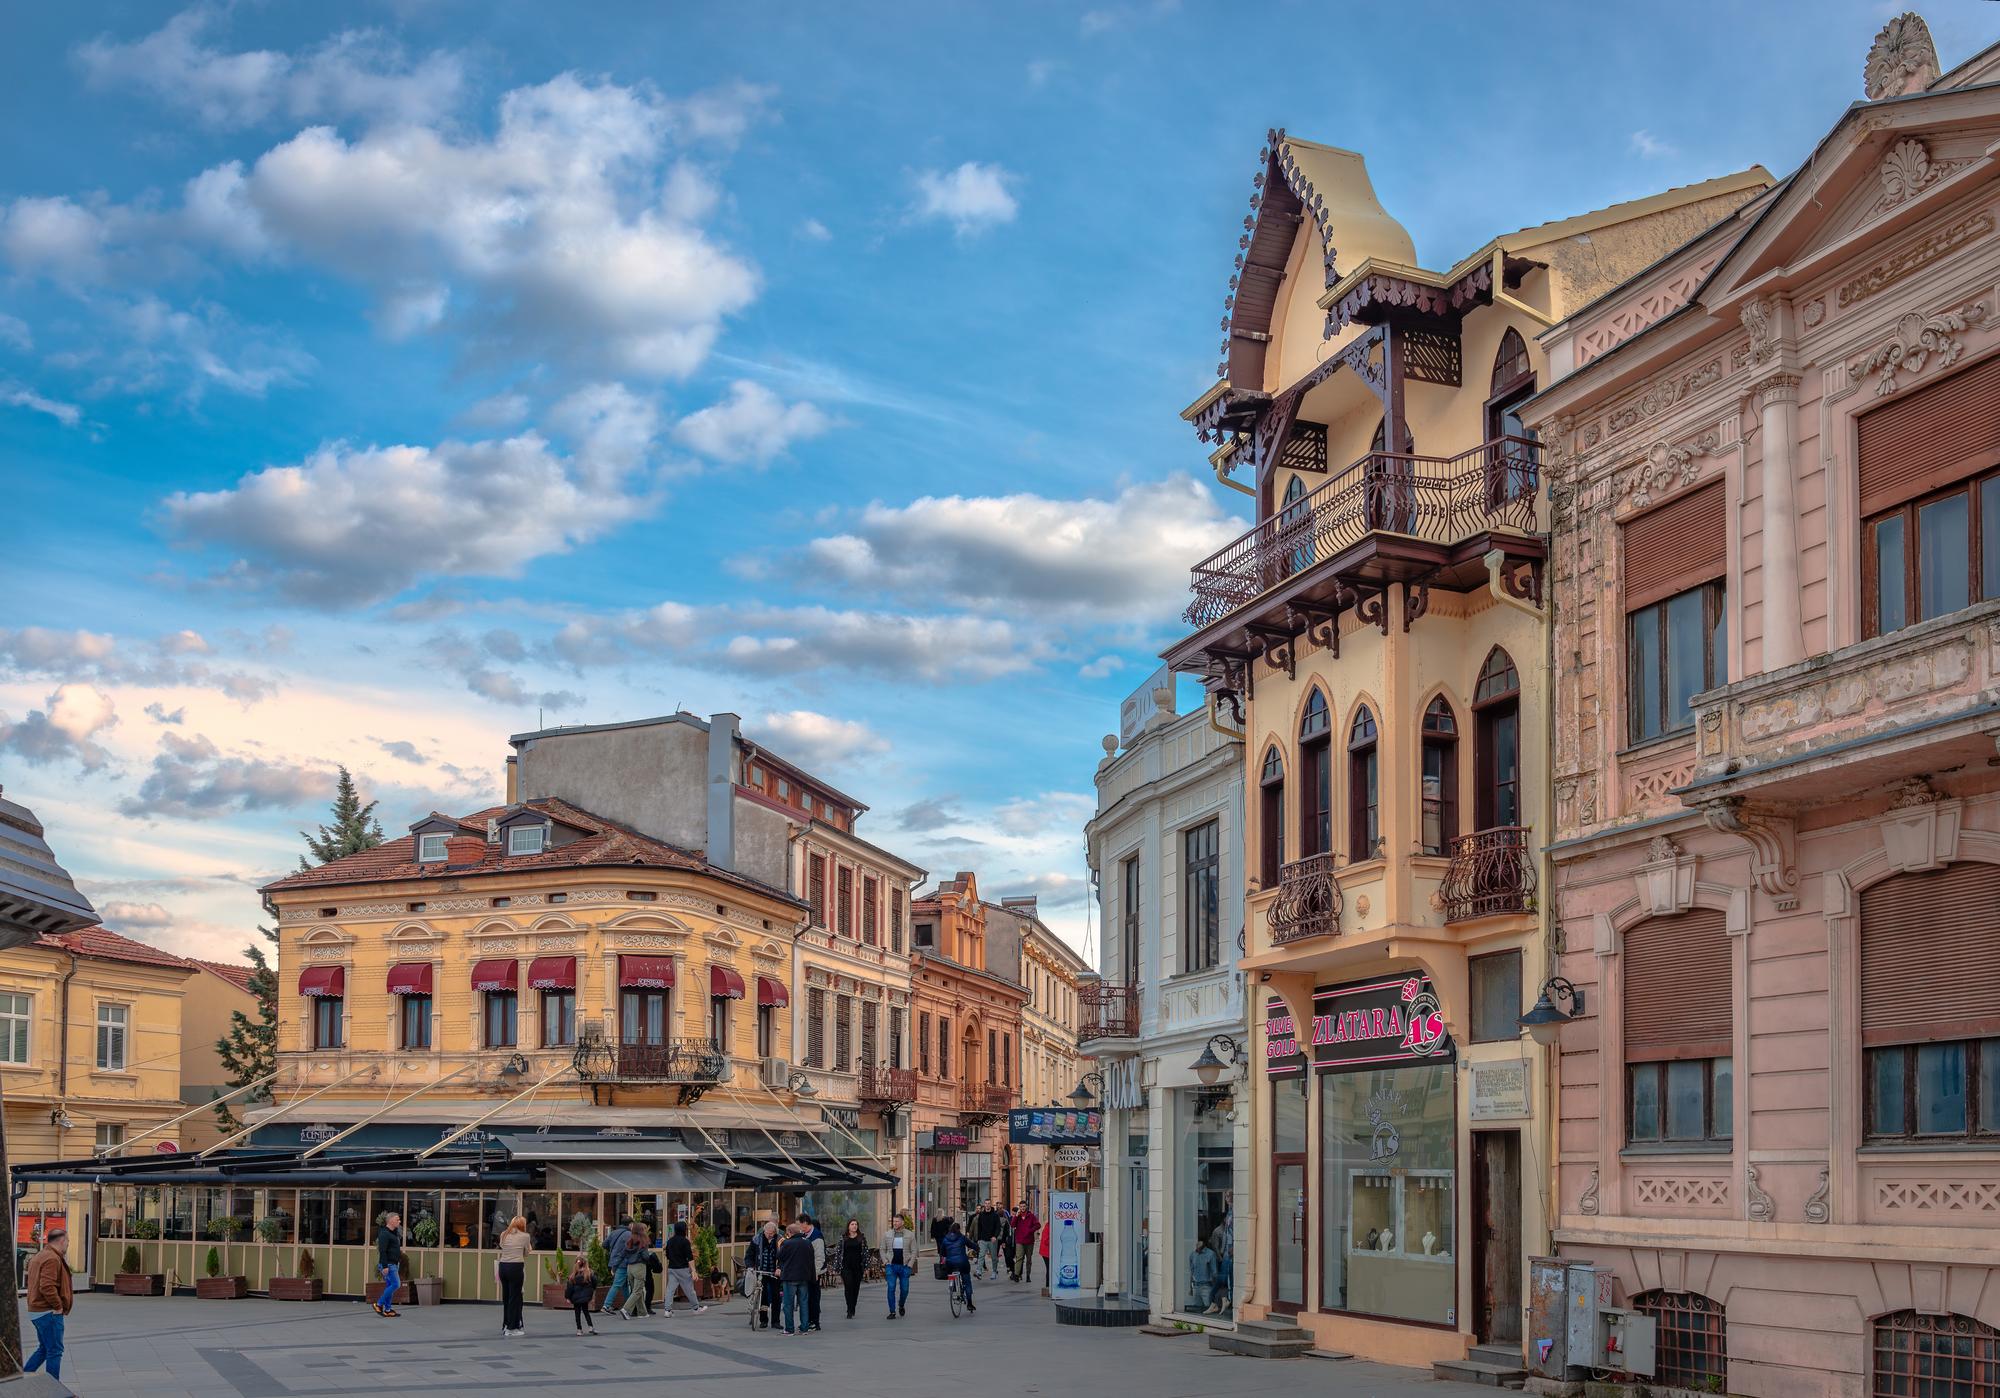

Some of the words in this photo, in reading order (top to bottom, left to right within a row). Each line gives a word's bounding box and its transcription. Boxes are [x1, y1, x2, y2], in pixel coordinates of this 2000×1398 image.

[1312, 1005, 1401, 1045] ZLATARA
[1400, 1010, 1444, 1049] AS
[1266, 1039, 1297, 1057] GOLD
[1368, 1135, 1399, 1161] AS
[1059, 1201, 1078, 1209] ROSA
